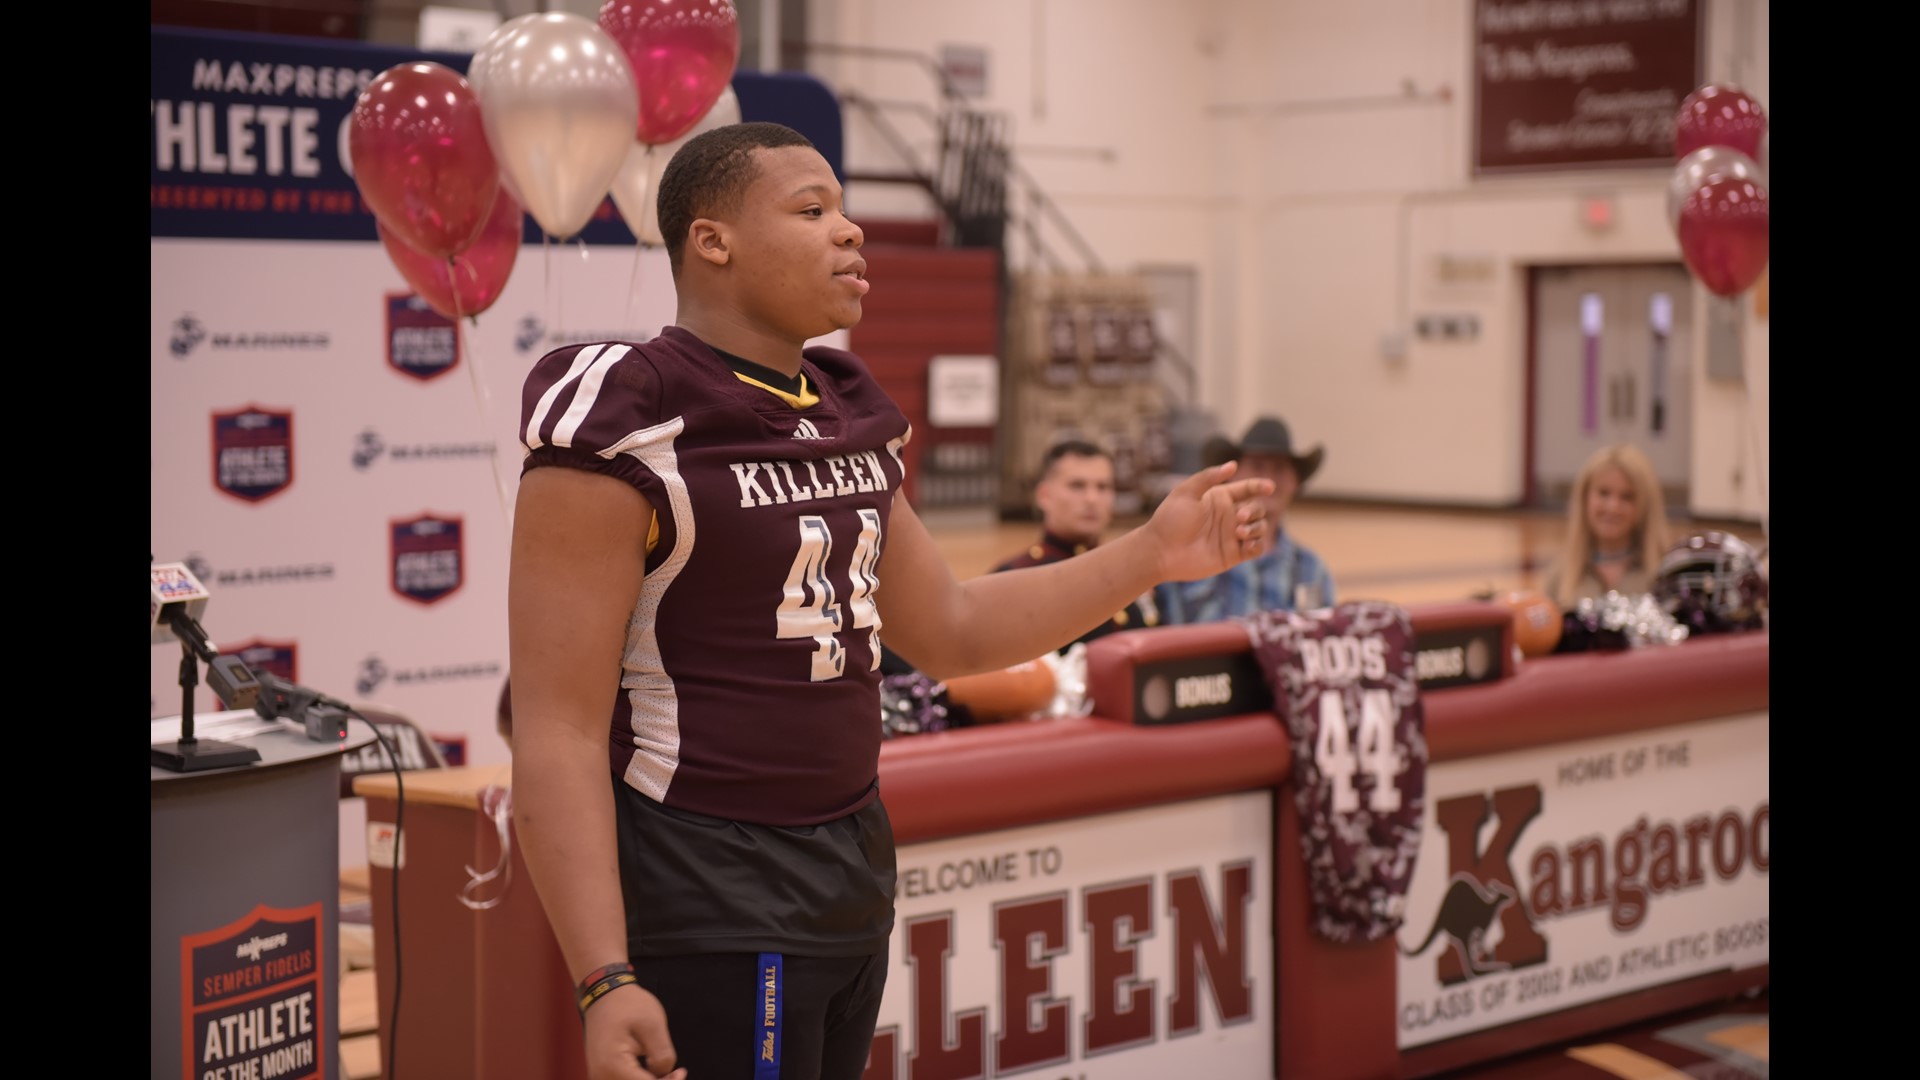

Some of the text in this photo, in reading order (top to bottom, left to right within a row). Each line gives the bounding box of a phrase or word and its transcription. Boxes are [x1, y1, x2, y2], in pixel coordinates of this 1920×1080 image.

[192, 57, 375, 100] MAXPREPS
[151, 99, 321, 178] HLETE
[729, 450, 888, 508] KILLEEN
[776, 508, 882, 682] 44
[1303, 635, 1387, 683] ROOS
[1175, 672, 1232, 708] BONUS
[1316, 688, 1402, 813] 44
[894, 846, 1062, 899] ELCOME TO
[203, 949, 312, 999] SEMPER FIDELIS
[764, 965, 776, 1027] FOOTBALL
[862, 857, 1254, 1080] LEEN
[203, 990, 313, 1064] ATHLETE
[261, 1038, 313, 1080] MONTH
